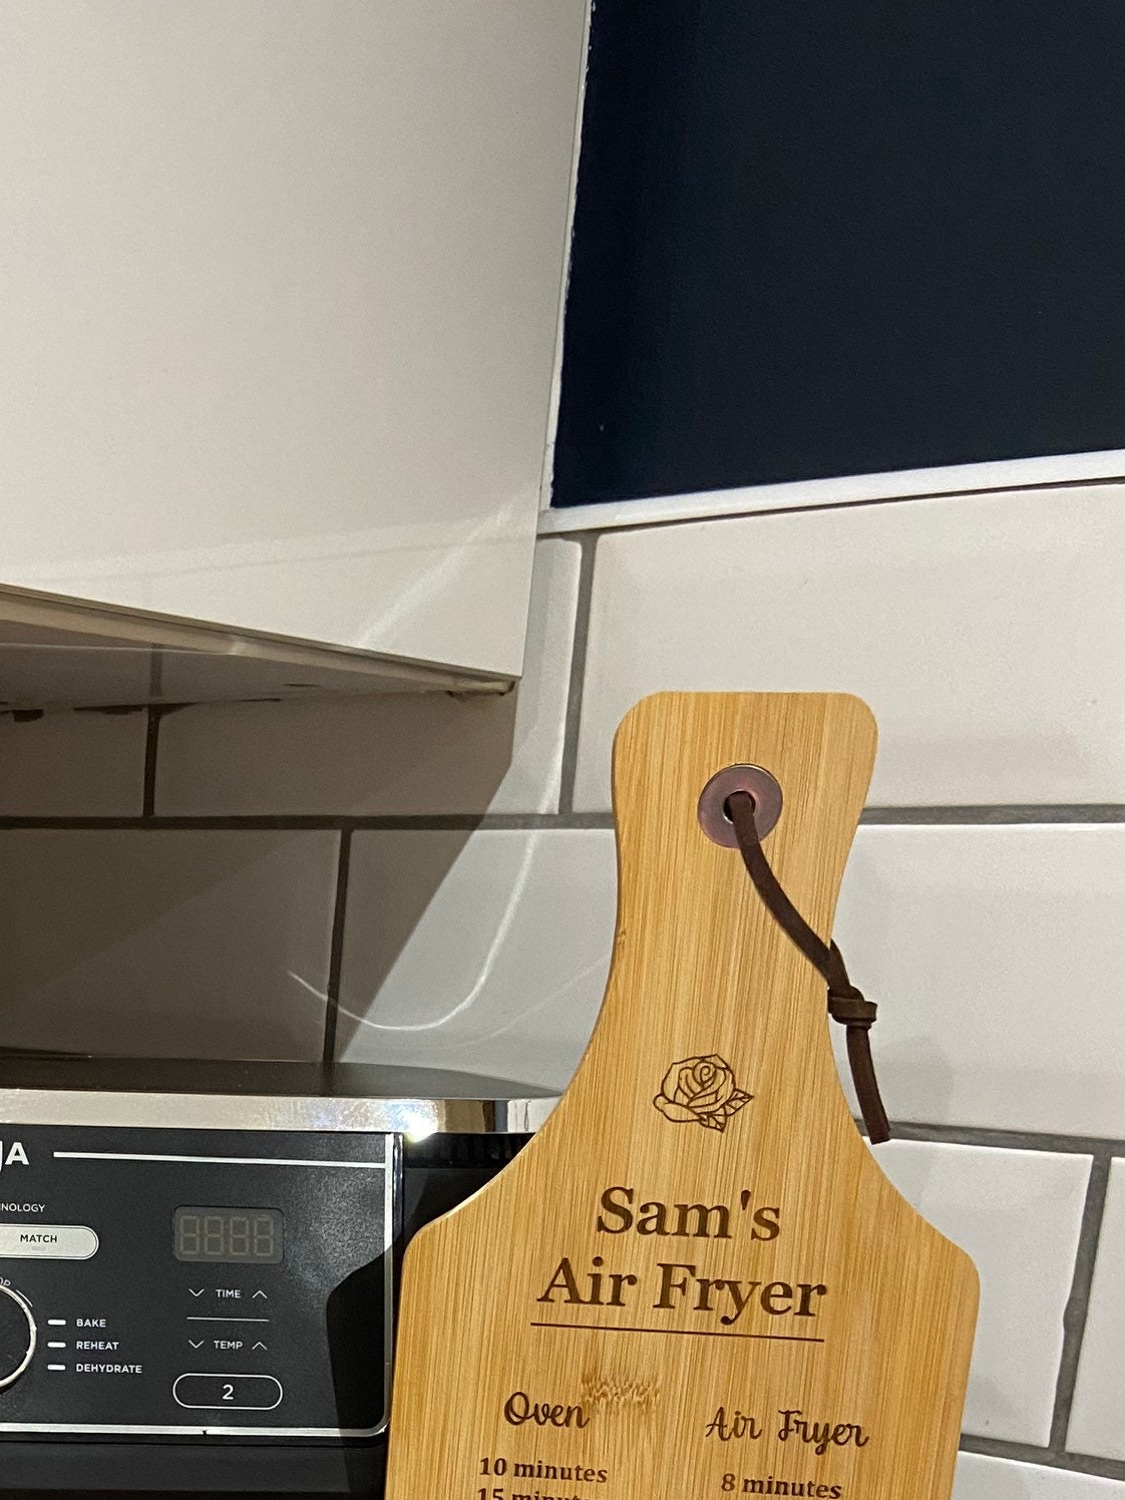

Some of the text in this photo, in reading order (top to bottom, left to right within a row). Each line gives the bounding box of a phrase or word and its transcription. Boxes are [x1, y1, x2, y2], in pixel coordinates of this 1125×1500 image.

[596, 1186, 781, 1241] Sam's
[20, 1235, 57, 1243] MATCH
[215, 1288, 241, 1299] TIME
[537, 1256, 827, 1326] Air Fryer
[76, 1318, 107, 1328] BAKE
[76, 1340, 119, 1351] REHEAT
[213, 1340, 243, 1351] TEMP
[76, 1363, 143, 1374] DEHYDRATE
[222, 1385, 234, 1400] 2
[504, 1391, 589, 1429] Oven
[705, 1407, 870, 1455] Air Fryer
[479, 1457, 608, 1483] 10 minutes
[721, 1474, 843, 1500] 8 minutes
